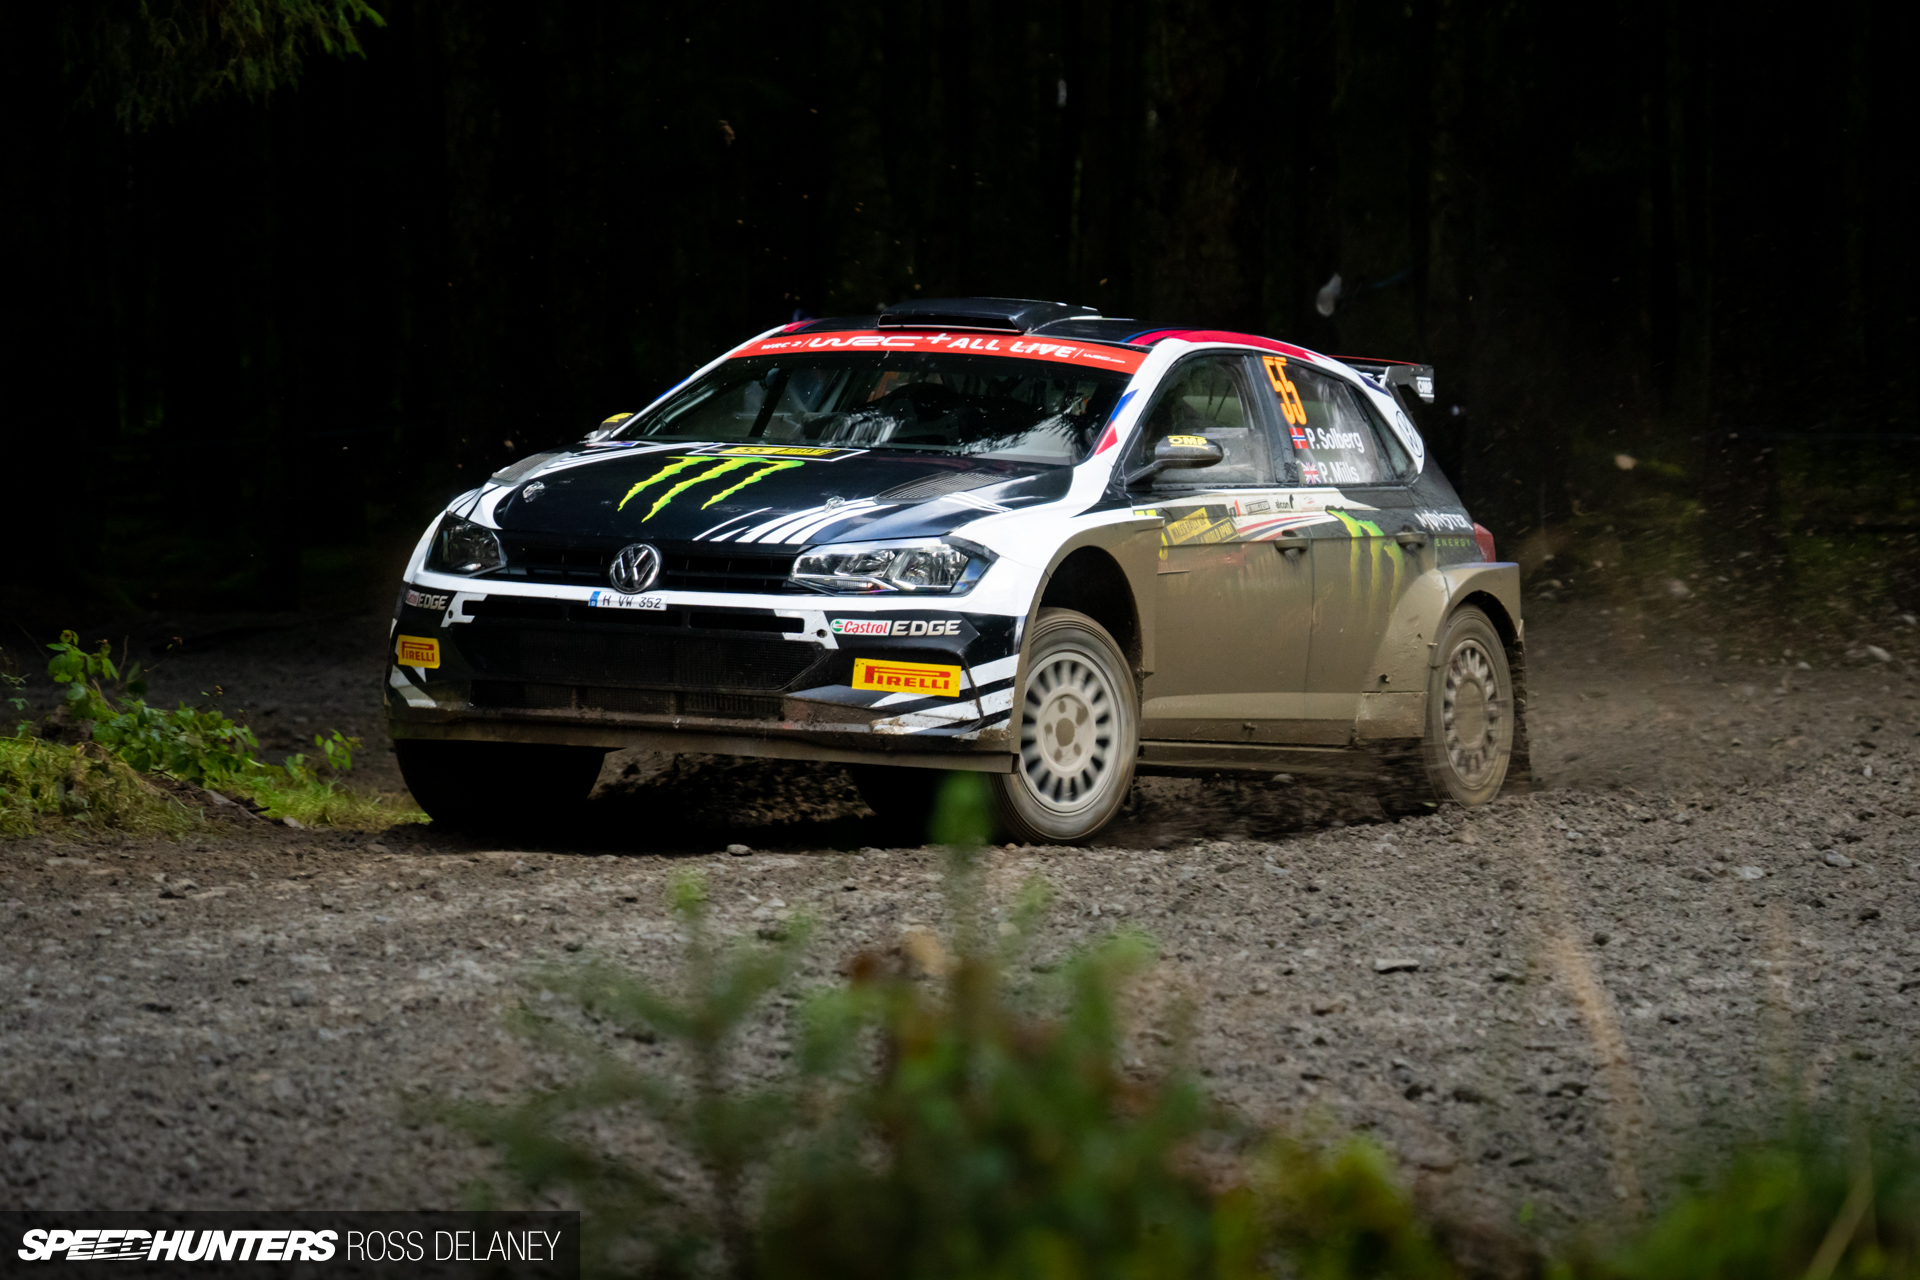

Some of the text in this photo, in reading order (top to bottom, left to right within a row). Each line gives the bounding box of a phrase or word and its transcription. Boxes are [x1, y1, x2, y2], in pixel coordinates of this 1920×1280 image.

[947, 337, 1000, 351] ALL
[1009, 341, 1077, 358] LIVE
[1262, 356, 1307, 425] 55
[1168, 436, 1208, 447] OMP
[1436, 538, 1471, 547] ENERGY
[418, 593, 449, 610] EDGE
[602, 595, 662, 608] H VW 352
[844, 620, 962, 636] Castrol EDGE
[402, 641, 435, 662] PIRELLI
[864, 665, 951, 690] PIRELLI
